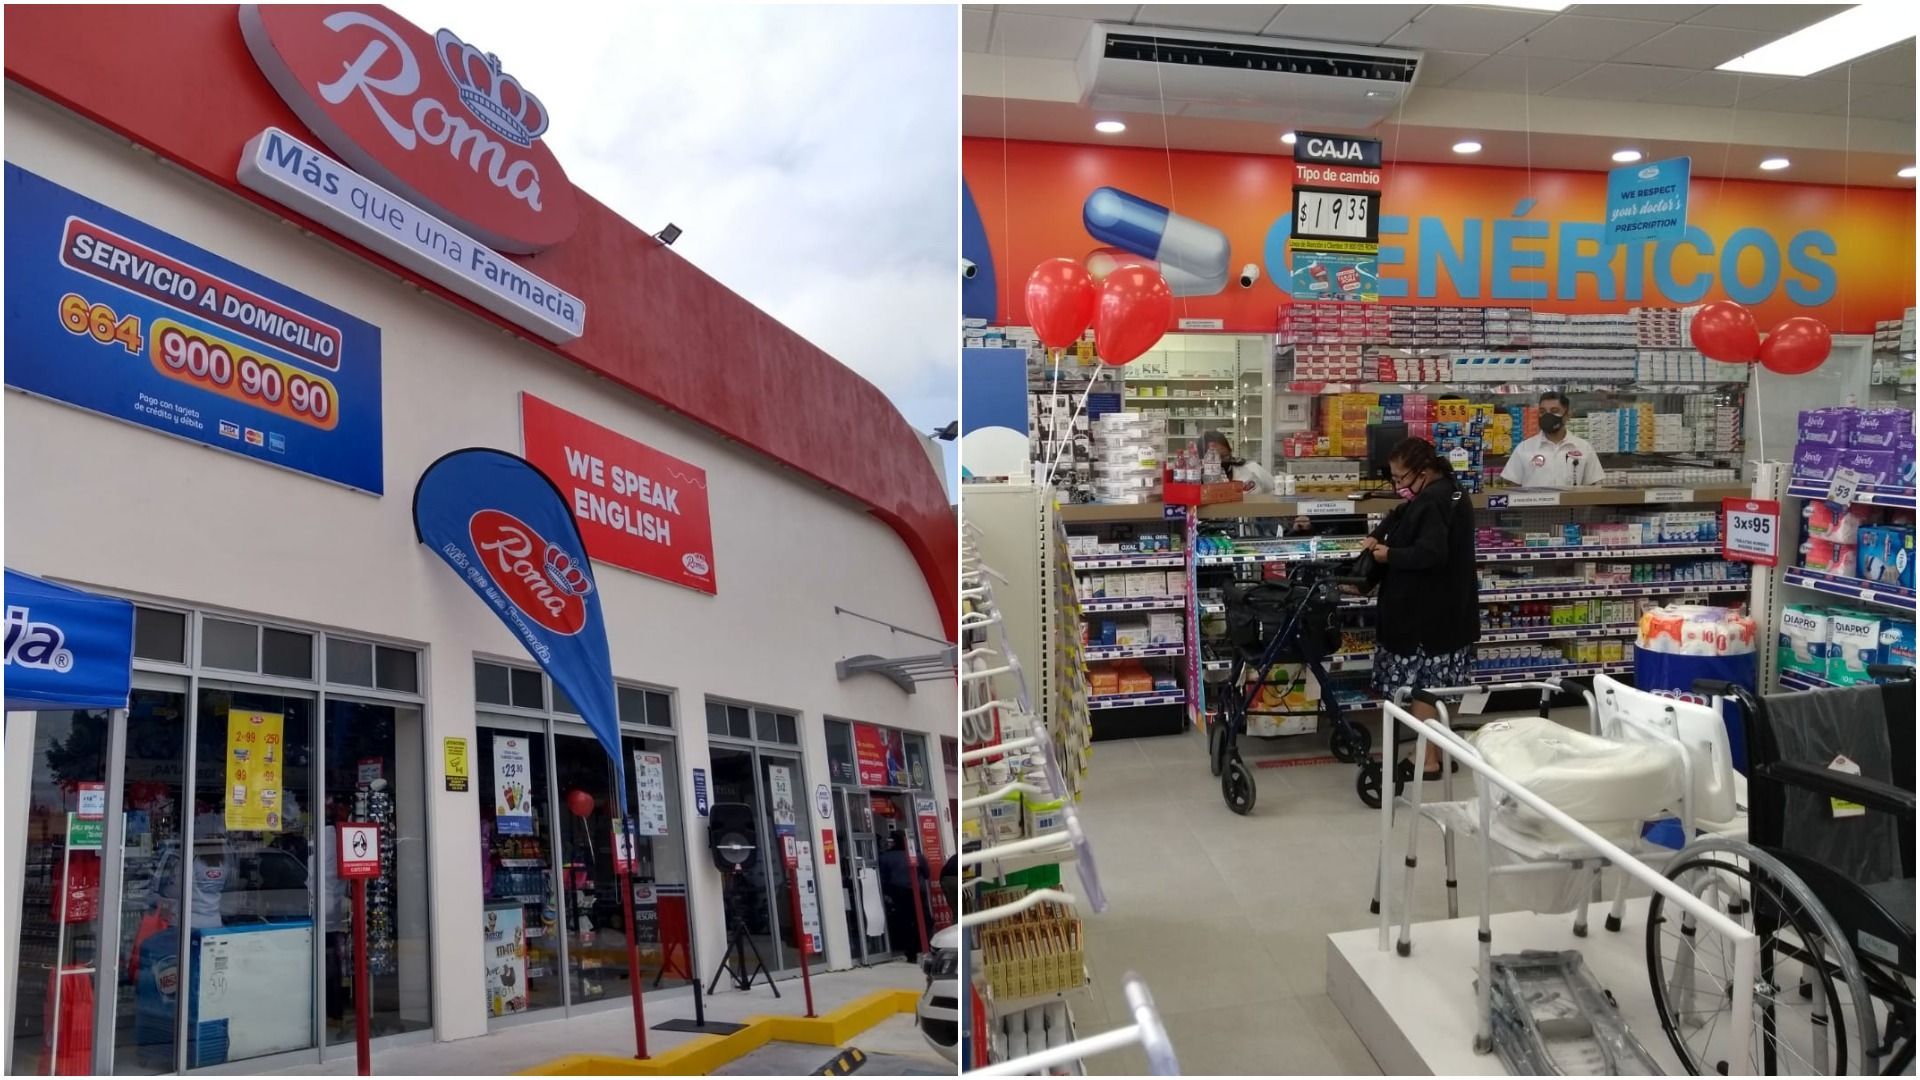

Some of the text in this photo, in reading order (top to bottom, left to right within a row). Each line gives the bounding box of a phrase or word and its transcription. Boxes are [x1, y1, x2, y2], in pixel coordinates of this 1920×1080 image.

[318, 11, 543, 212] Roma
[1307, 138, 1363, 161] CAJA
[1296, 165, 1380, 185] Tipo de cambio
[265, 133, 339, 196] Más
[350, 182, 404, 231] que
[415, 220, 464, 263] una
[1621, 184, 1677, 200] WE RESPECT
[1610, 194, 1681, 222] your doctor's
[1615, 218, 1678, 233] PRESCRIPTION
[72, 234, 334, 357] SERVICIO A DOMICILIO
[59, 293, 328, 419] 664 900 90 90
[134, 402, 203, 429] de crédito y débito
[139, 392, 199, 418] Pago con tarjeta
[564, 446, 681, 515] WE SPEAK
[574, 488, 671, 546] ENGLISH
[443, 542, 470, 569] Más
[467, 566, 489, 589] que
[481, 525, 566, 619] Roma
[1783, 613, 1816, 629] DIAPRO
[1835, 621, 1870, 635] DIAPRO
